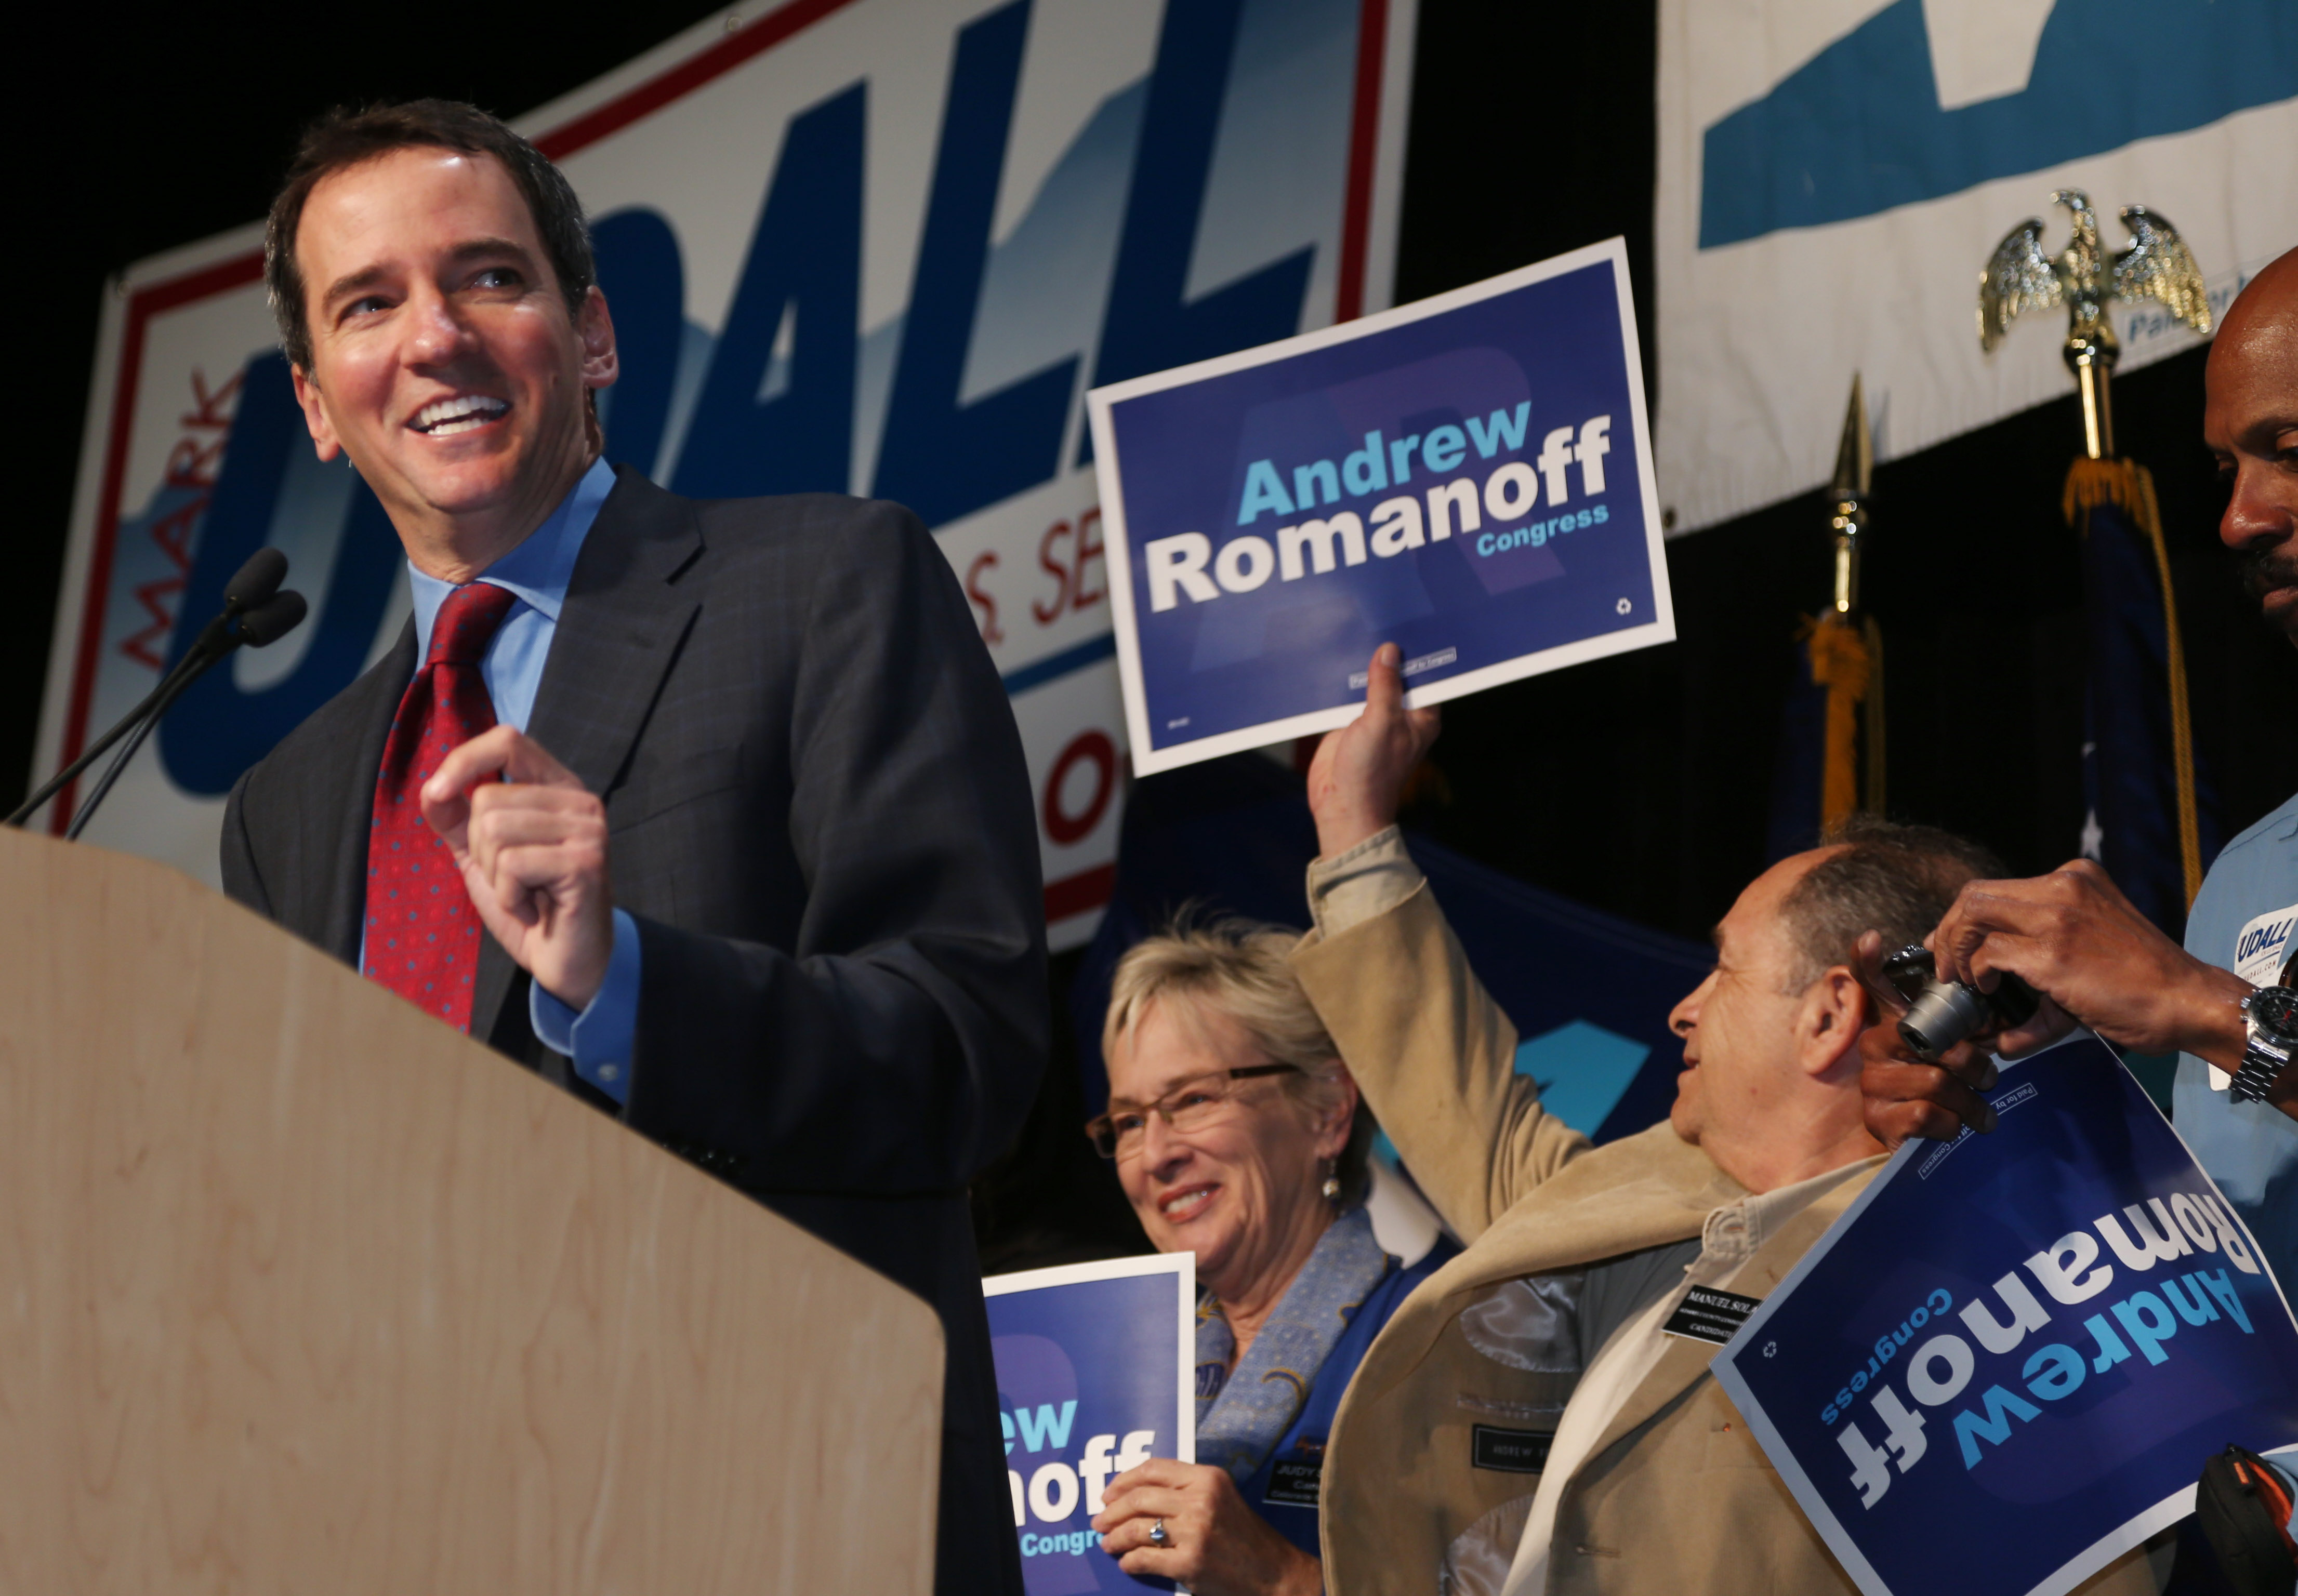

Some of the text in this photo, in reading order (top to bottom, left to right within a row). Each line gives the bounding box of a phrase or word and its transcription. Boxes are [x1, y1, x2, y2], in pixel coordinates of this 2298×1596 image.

[119, 364, 246, 672] MARK
[1145, 414, 1610, 614] Romanoff
[1237, 400, 1531, 526] Andrew
[1476, 502, 1609, 558] Congress
[2238, 917, 2294, 963] UDALL
[1922, 1143, 1951, 1174] Congress
[1996, 1087, 2033, 1109] Paid for by
[1688, 1291, 1731, 1309] MANUEL
[1821, 1288, 1953, 1426] Congress
[1837, 1193, 2261, 1510] Romanoff
[1953, 1268, 2255, 1470] Andrew
